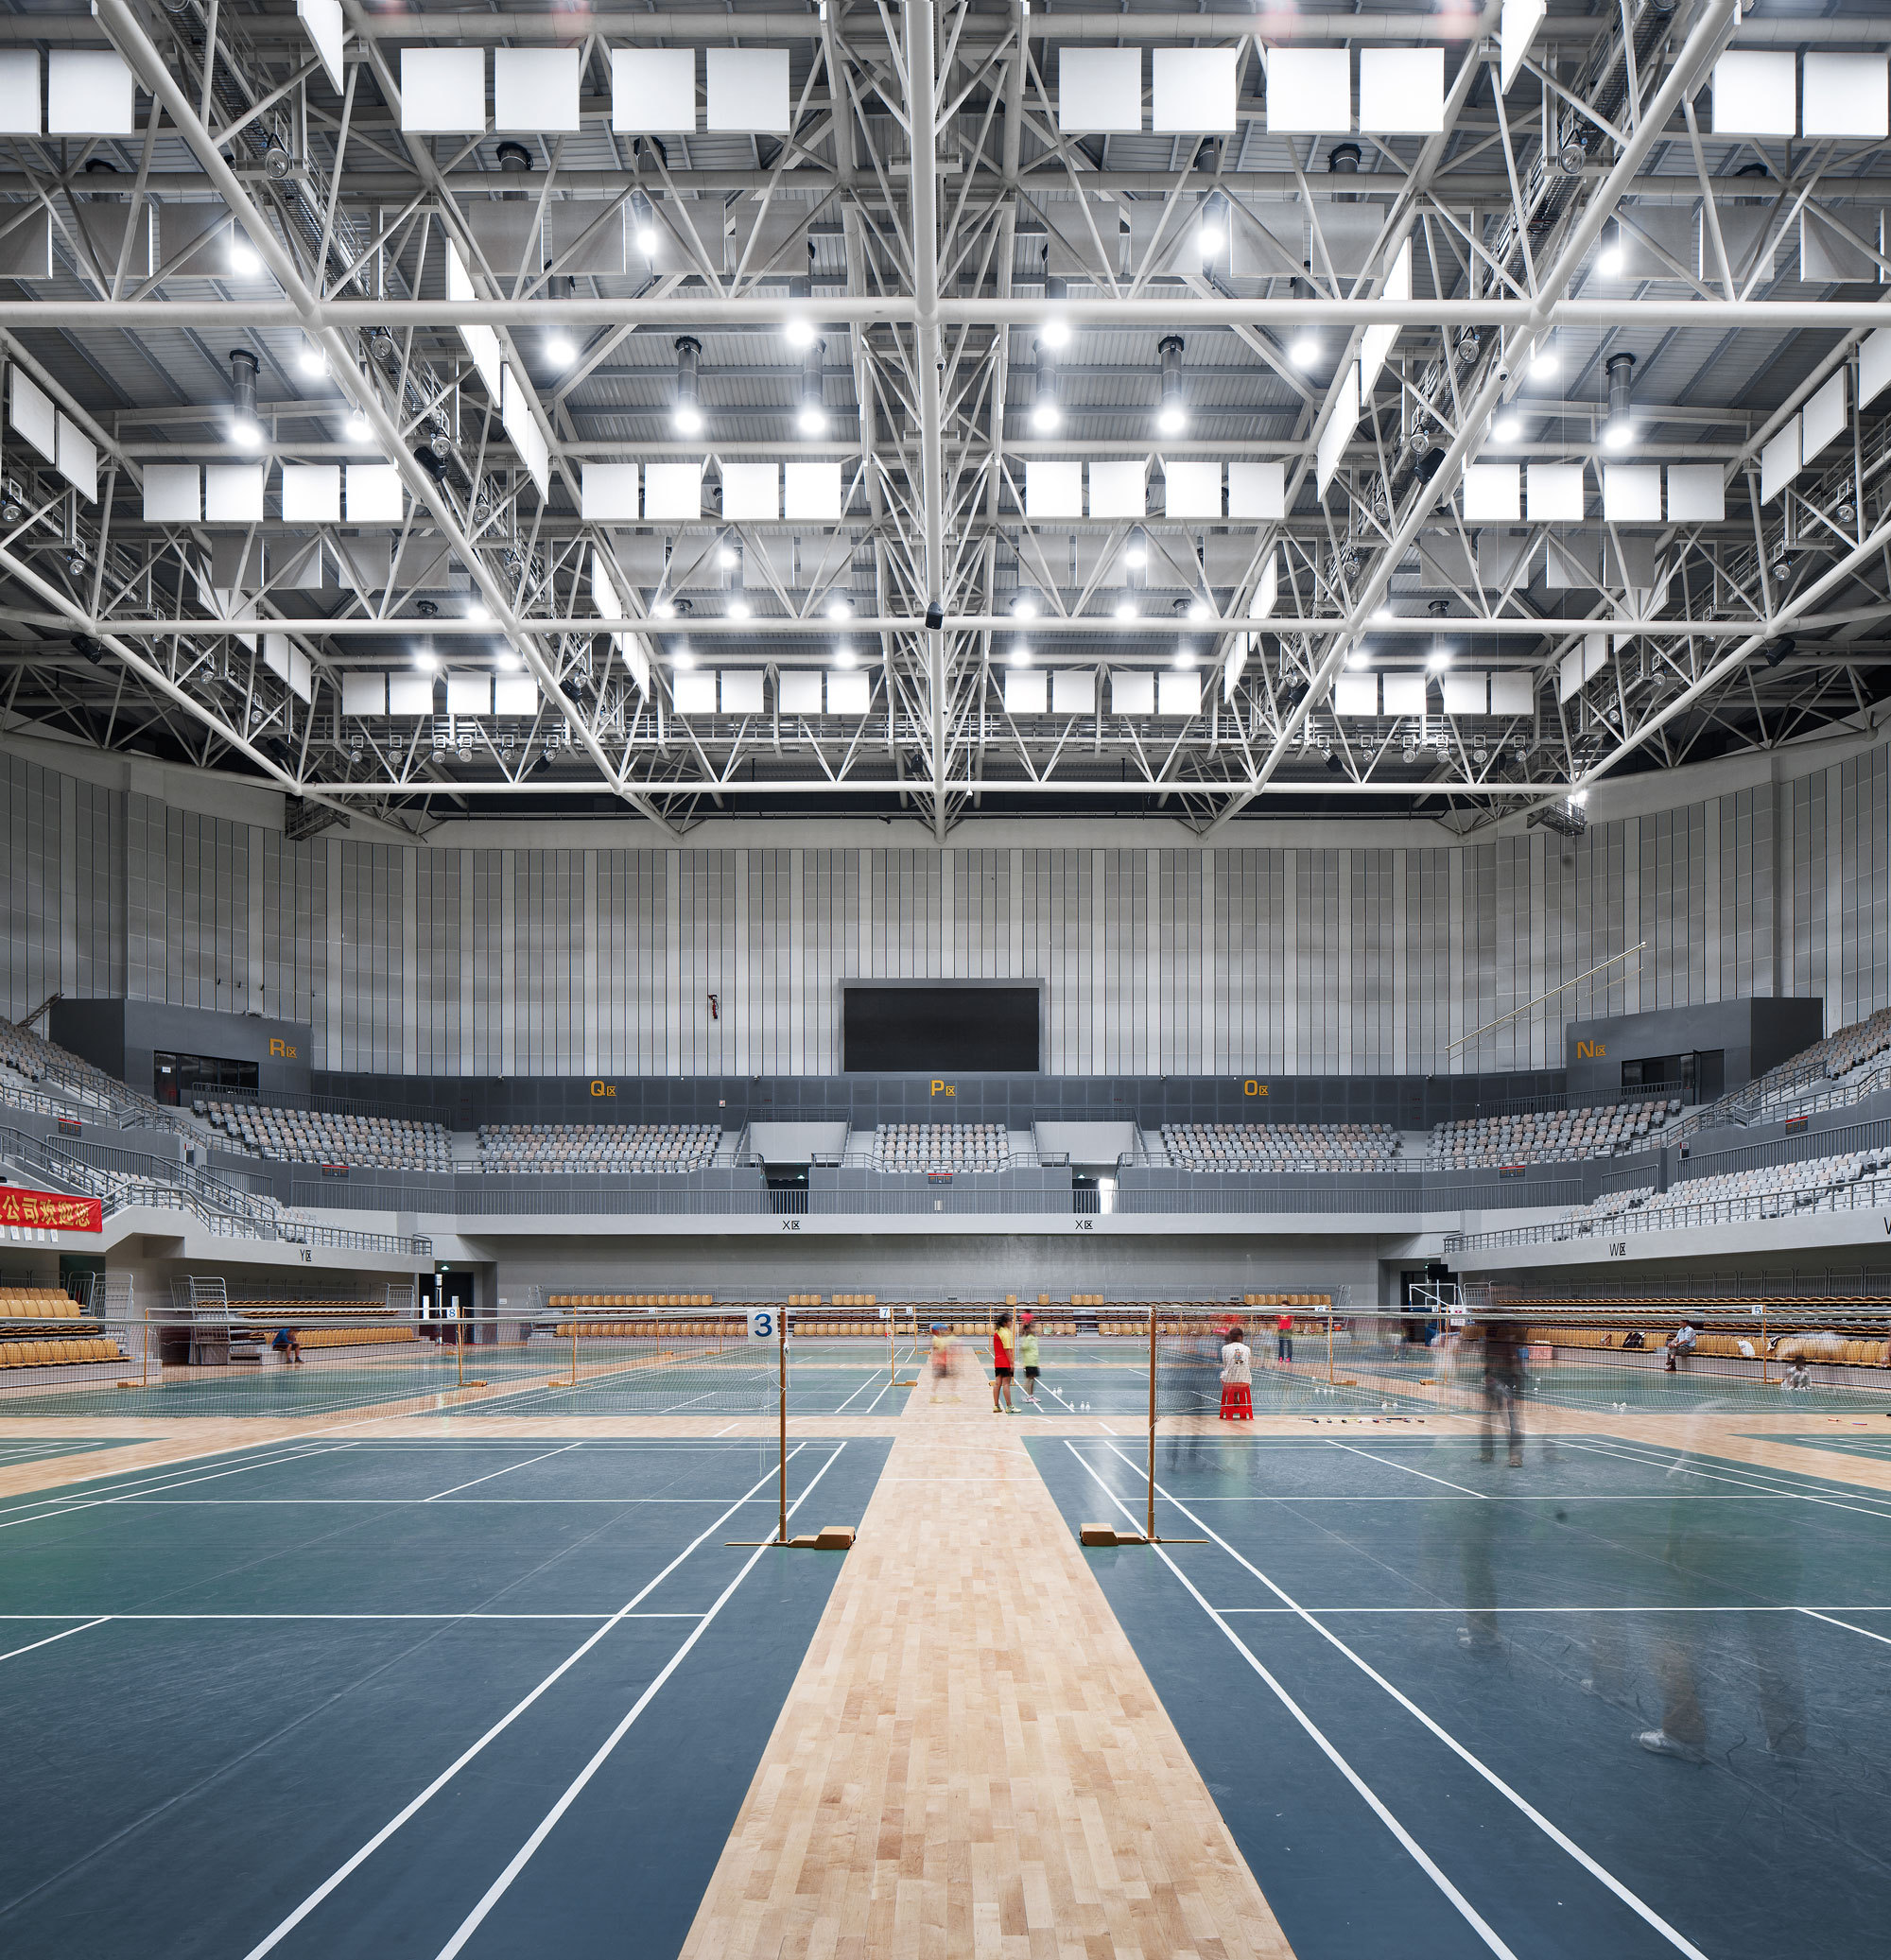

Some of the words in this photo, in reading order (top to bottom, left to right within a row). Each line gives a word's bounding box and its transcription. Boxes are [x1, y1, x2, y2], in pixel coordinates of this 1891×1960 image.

[269, 1037, 297, 1059] R区
[1577, 1039, 1606, 1059] N区
[590, 1080, 617, 1097] Q区
[930, 1080, 956, 1097] P区
[0, 1194, 91, 1227] 公司欢迎您
[782, 1220, 801, 1230] X区
[1075, 1220, 1094, 1230] X区
[300, 1249, 312, 1262] Y区
[1609, 1242, 1626, 1257] W区
[448, 1309, 456, 1317] 8
[882, 1308, 889, 1317] 7
[1754, 1306, 1762, 1315] 5
[754, 1312, 772, 1338] 3
